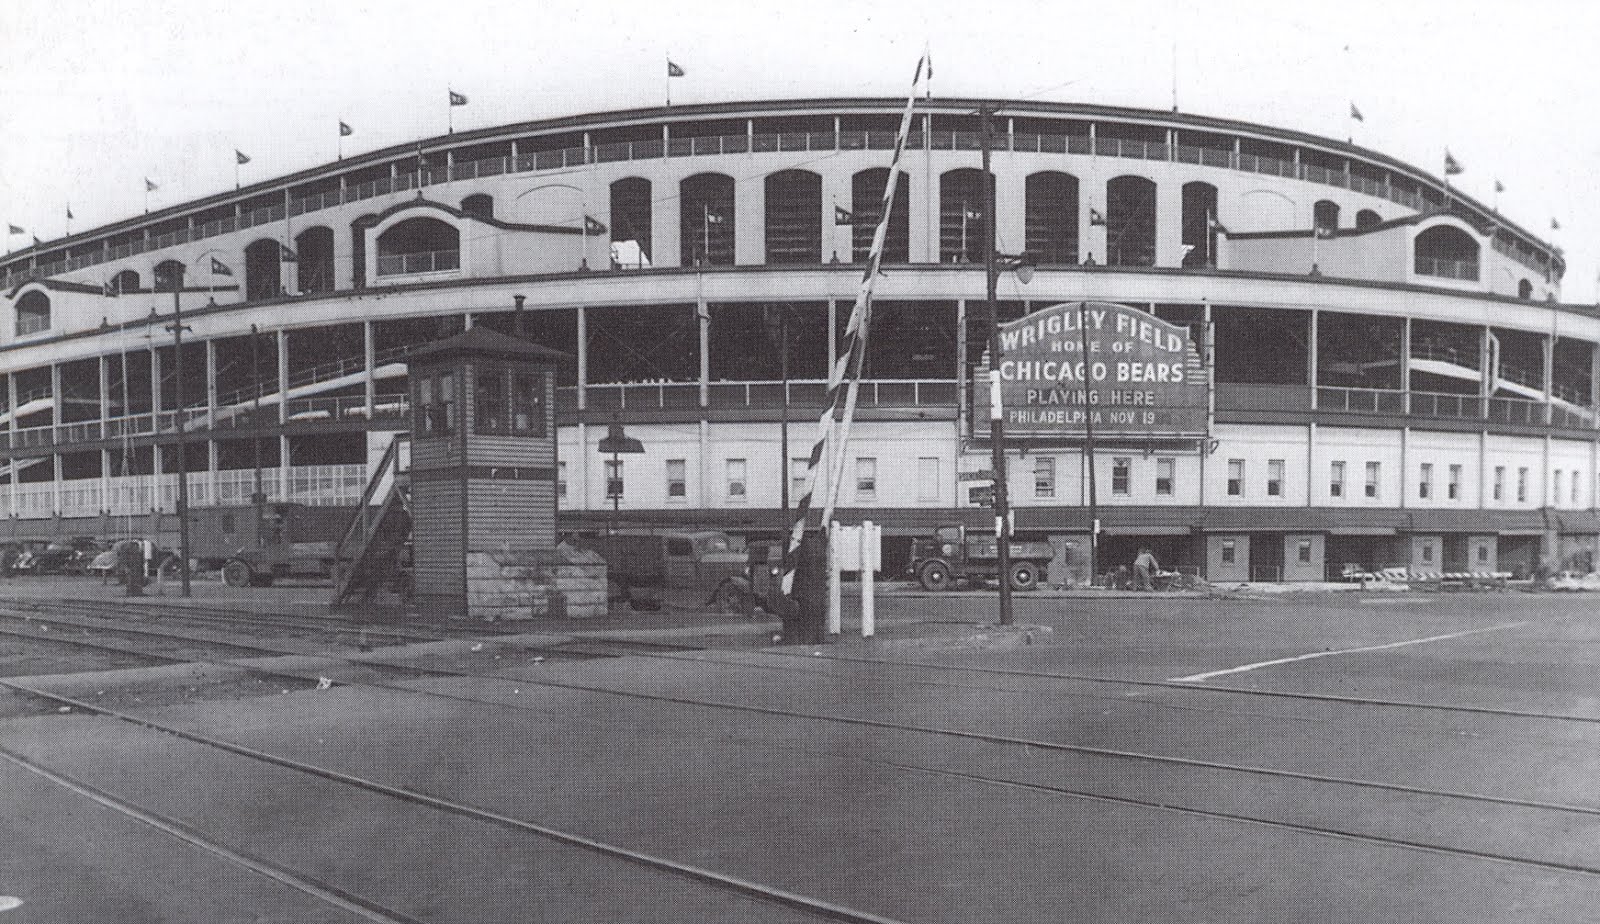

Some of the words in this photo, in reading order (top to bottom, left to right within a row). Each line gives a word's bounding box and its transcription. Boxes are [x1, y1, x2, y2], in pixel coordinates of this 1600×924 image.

[1000, 310, 1106, 351] WRIGLEY
[1117, 313, 1182, 352] FIELD
[1052, 341, 1100, 352] HOME
[1112, 341, 1134, 352] OF
[1000, 361, 1106, 381] CHICAGO
[1117, 362, 1184, 382] BEARS
[1027, 390, 1099, 405] PLAYING
[1112, 390, 1155, 405] HERE
[1009, 410, 1102, 424] PHILADELPHIA
[1110, 411, 1135, 424] NOV
[1143, 411, 1155, 424] 19
